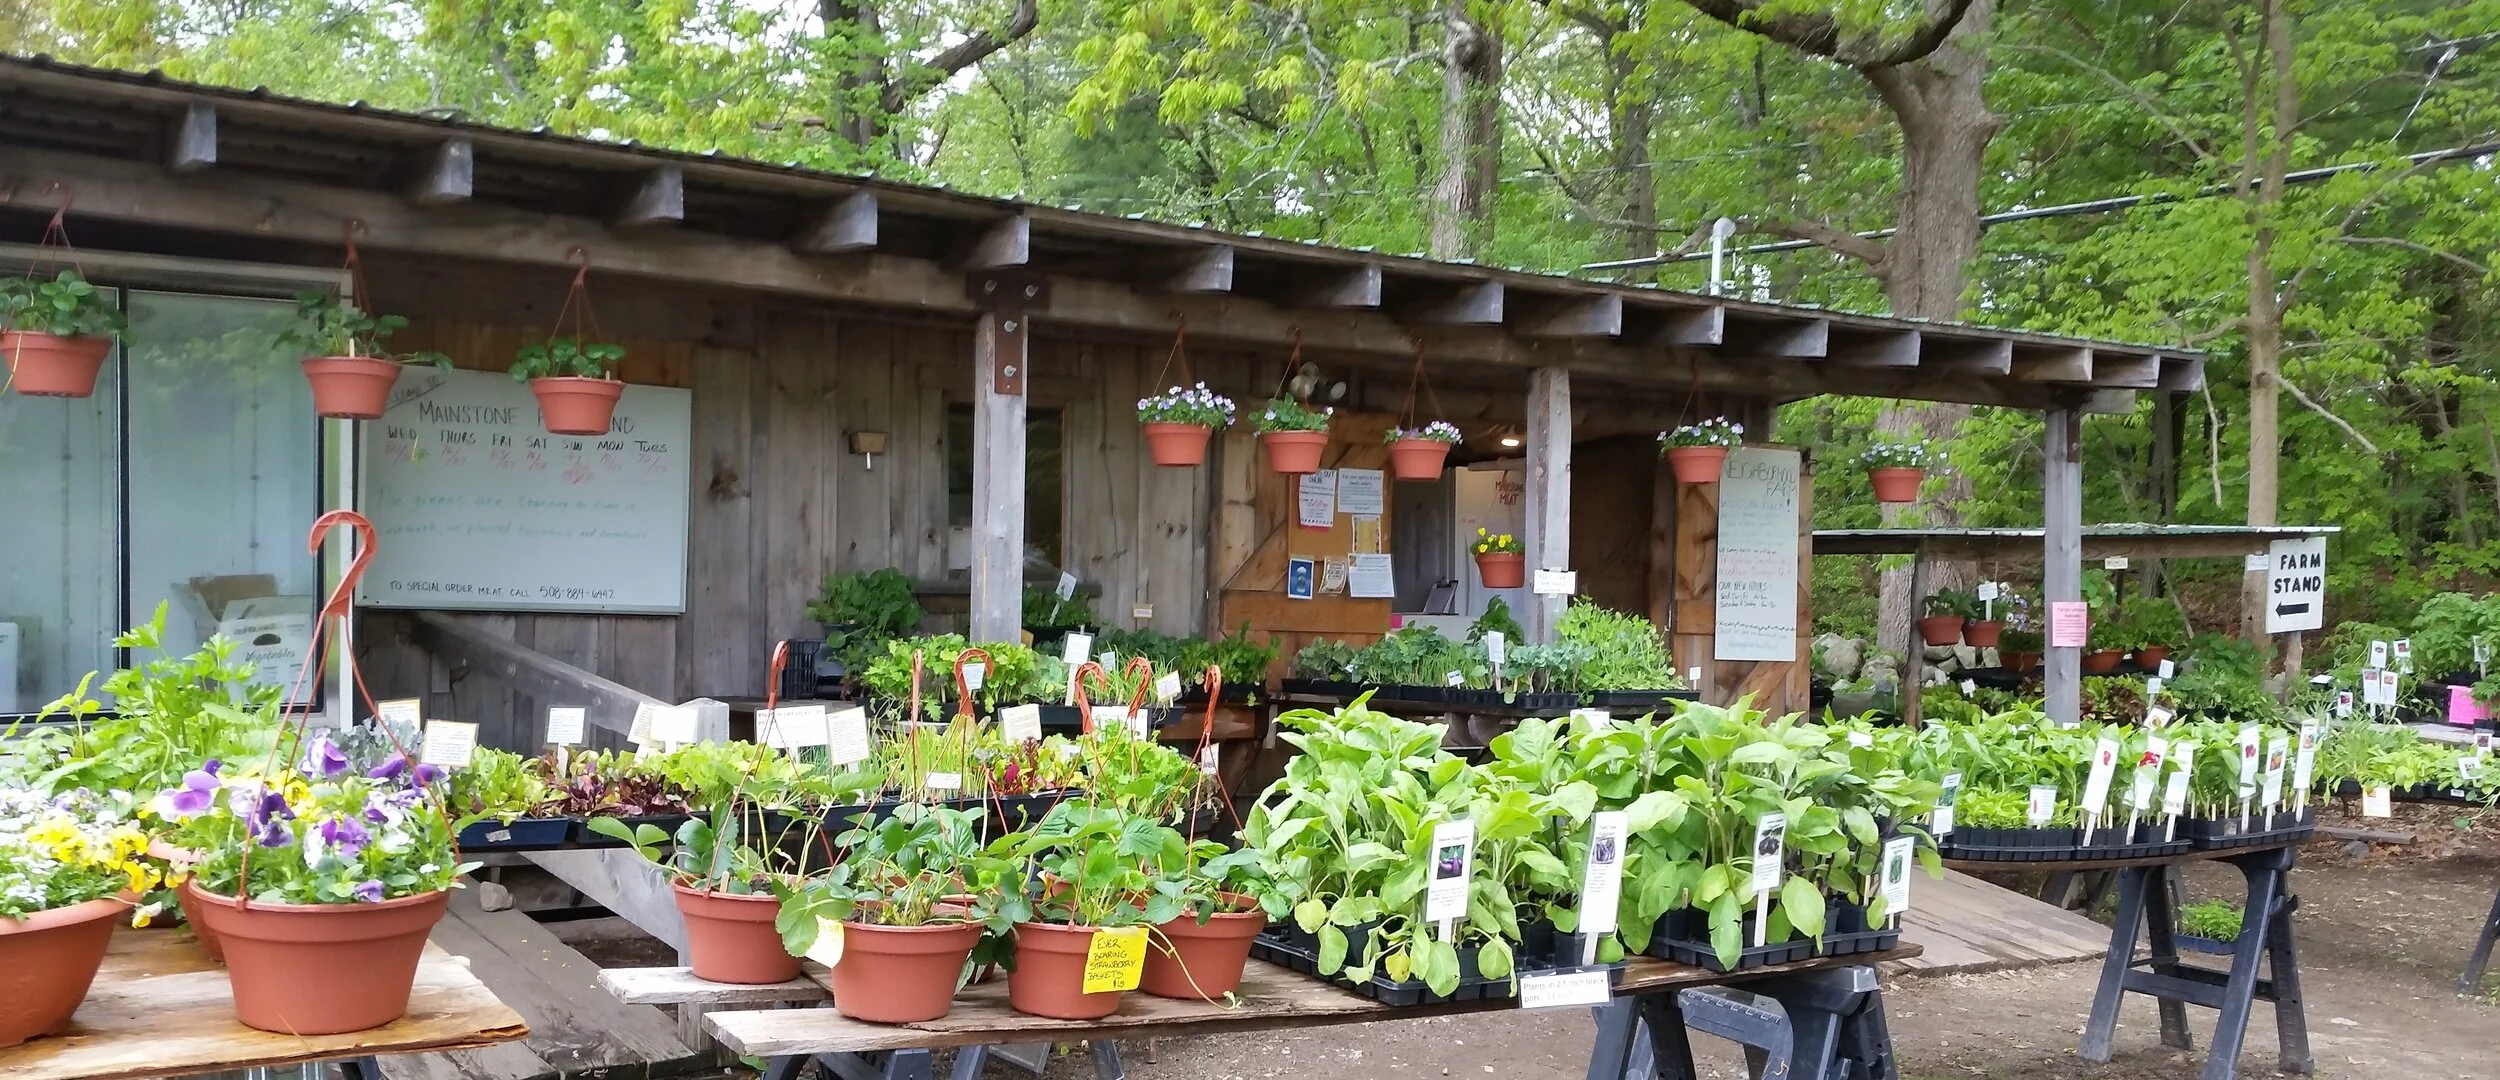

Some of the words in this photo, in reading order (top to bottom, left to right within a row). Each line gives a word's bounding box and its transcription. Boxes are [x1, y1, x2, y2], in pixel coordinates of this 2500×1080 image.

[419, 401, 519, 426] MAINSTONE
[440, 429, 476, 445] THURS
[493, 433, 512, 448] FRI
[526, 437, 549, 449] SAT
[597, 440, 625, 451] MON
[2280, 553, 2321, 570] FARM
[390, 580, 402, 591] TO
[407, 581, 440, 592] SPECIAL
[445, 583, 473, 593] ORDER
[510, 588, 530, 598] CALL
[2274, 576, 2321, 594] STAND
[245, 648, 296, 661] Vegetables
[1093, 950, 1128, 961] BEARING
[1090, 959, 1136, 971] STRAWBERRY
[1087, 970, 1124, 981] BASKETS
